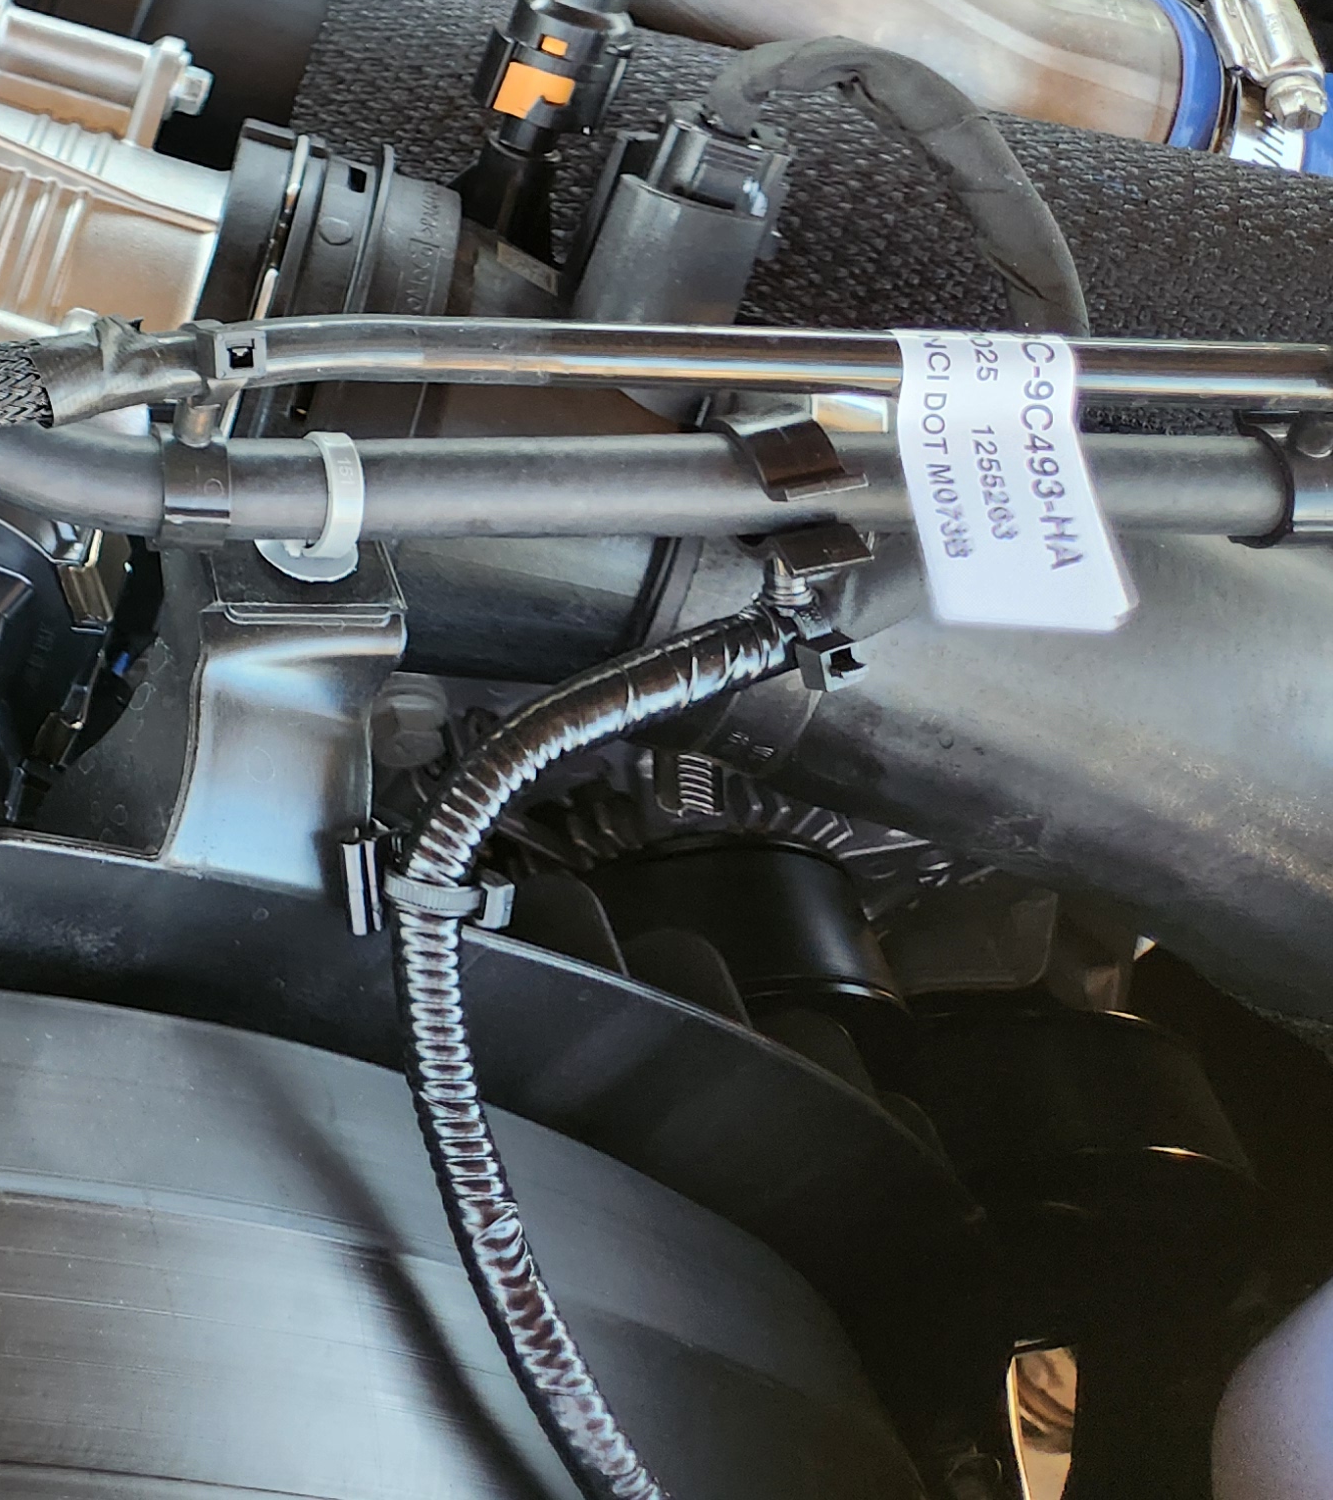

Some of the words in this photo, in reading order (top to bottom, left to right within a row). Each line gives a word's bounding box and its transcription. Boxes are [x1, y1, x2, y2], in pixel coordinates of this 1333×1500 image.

[922, 393, 948, 454] DOT
[1020, 333, 1085, 570] C-9C493-HA
[336, 457, 354, 485] 151
